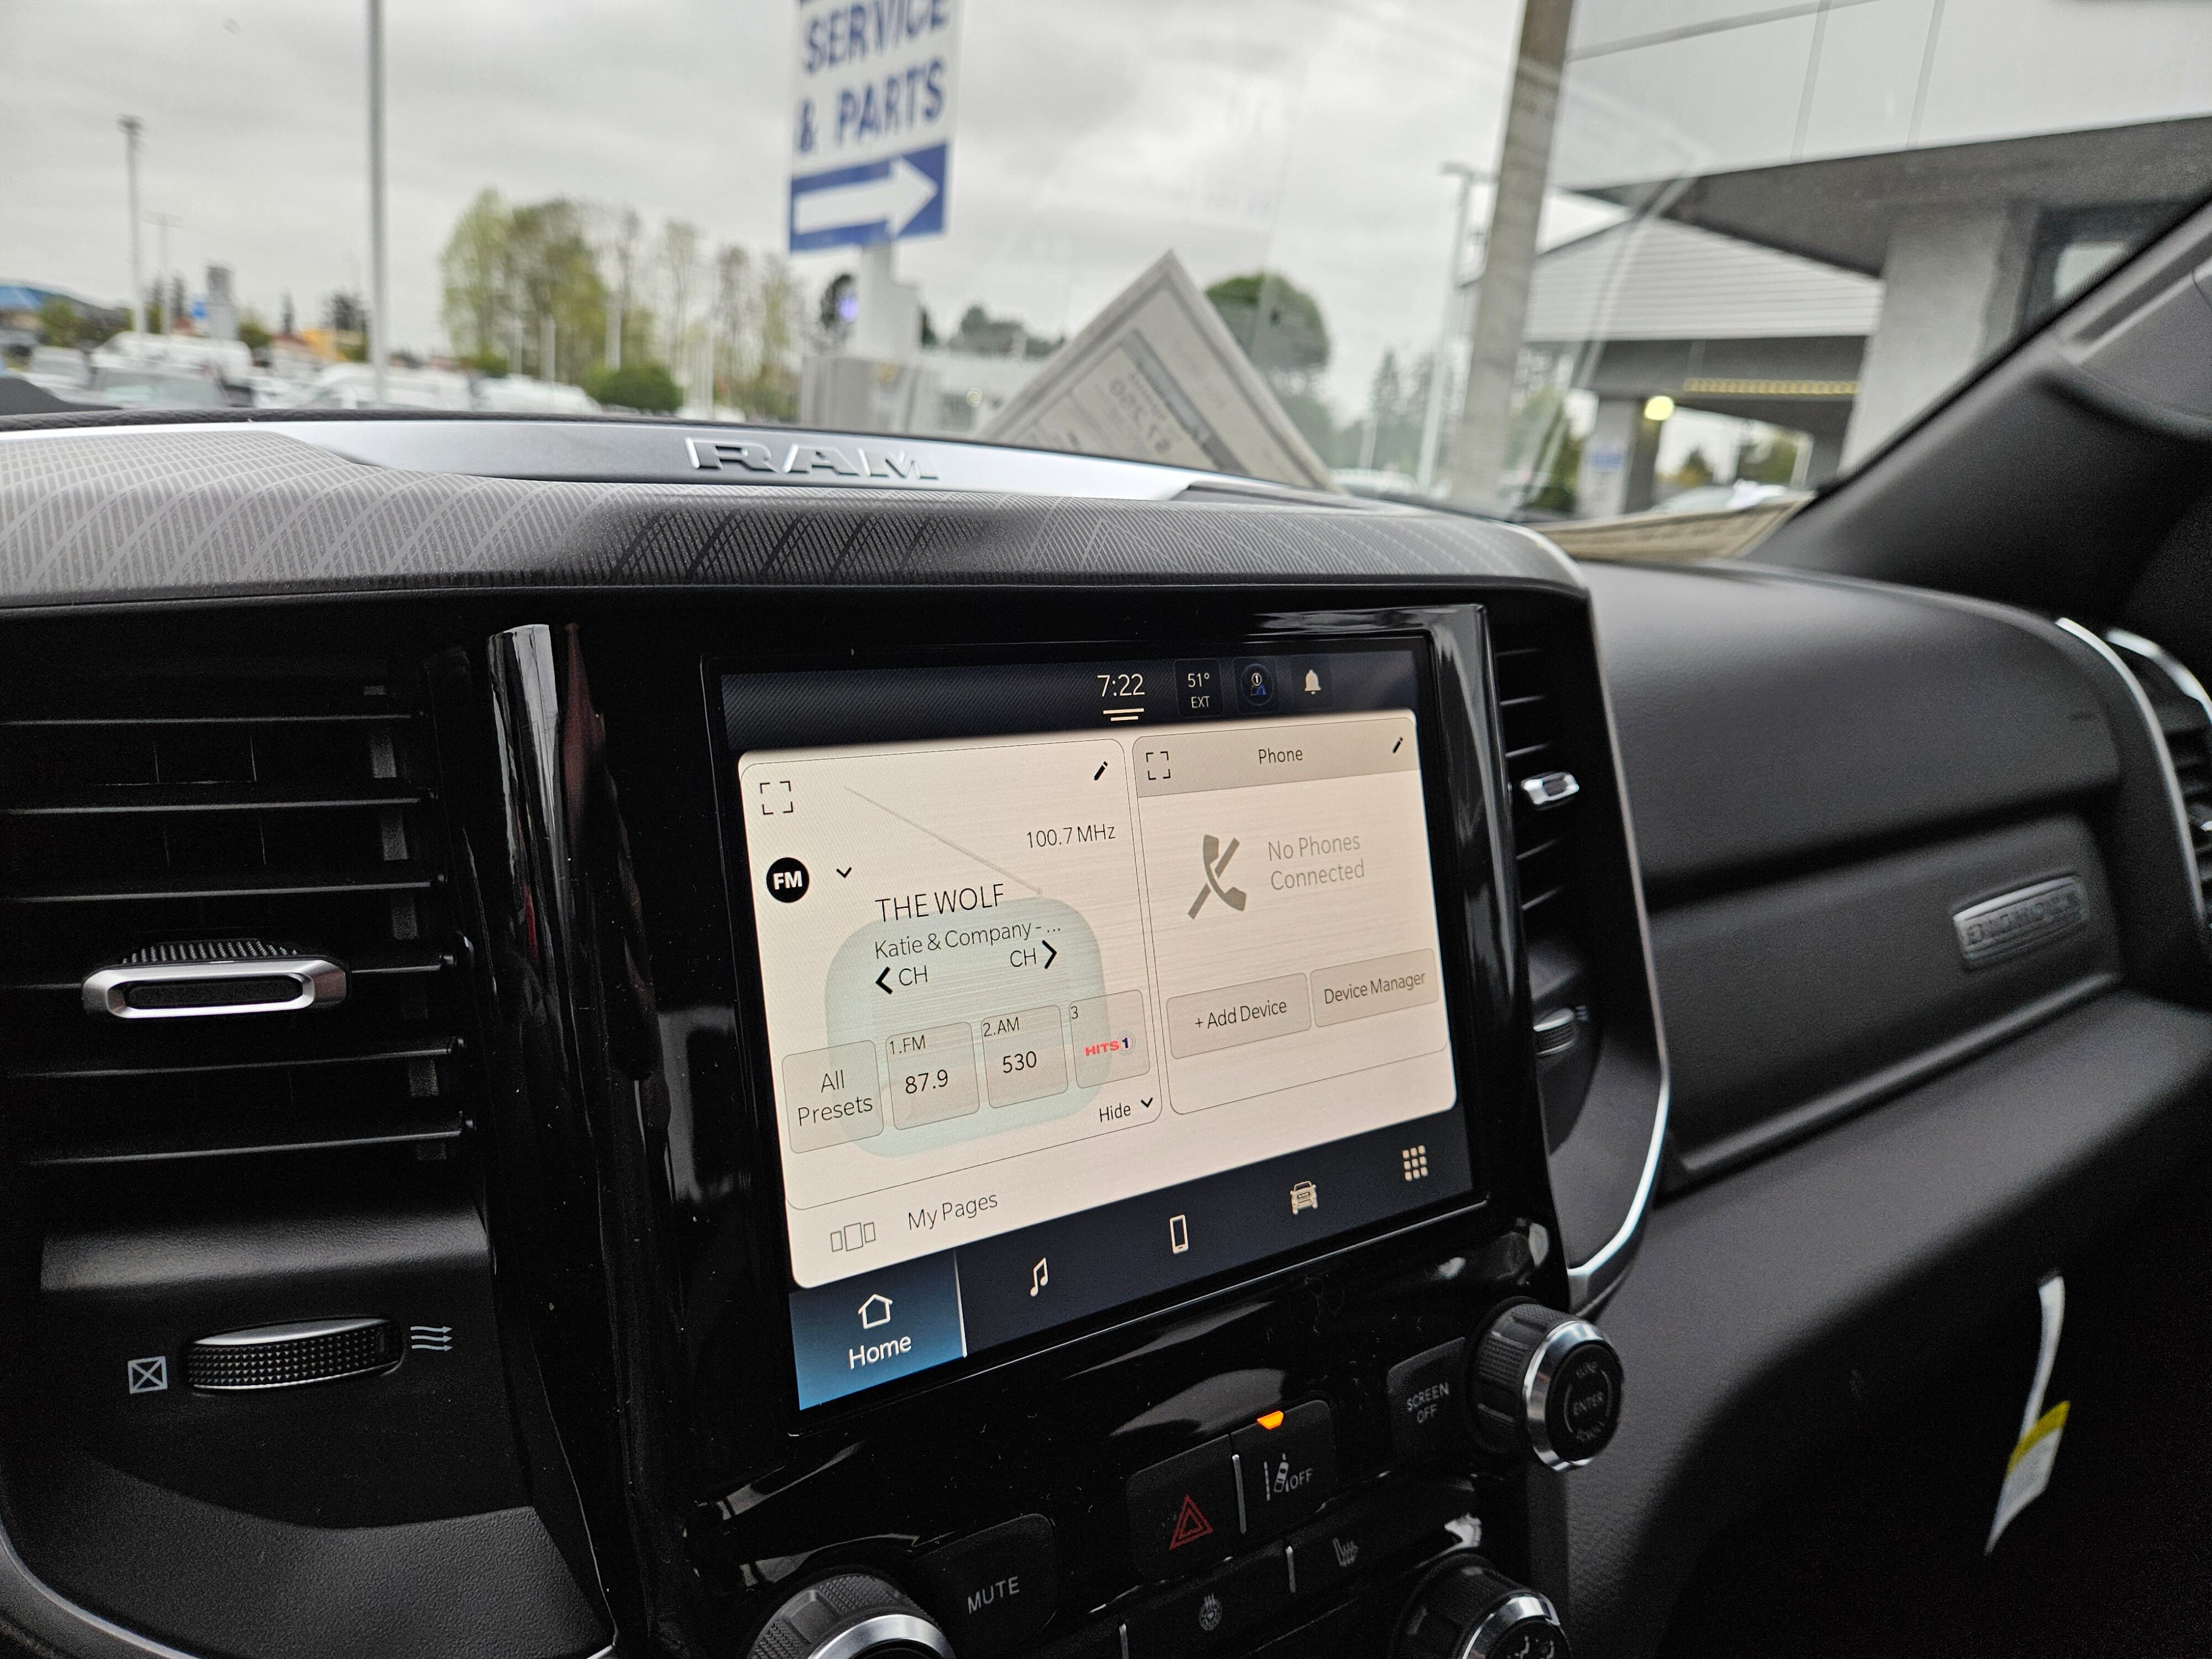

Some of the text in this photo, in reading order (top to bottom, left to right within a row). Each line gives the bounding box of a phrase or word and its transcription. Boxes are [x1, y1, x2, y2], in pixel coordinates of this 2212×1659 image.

[800, 59, 945, 155] & PARTS
[685, 437, 940, 480] RAM
[1097, 674, 1145, 697] 7:22
[1187, 672, 1210, 688] 51°
[1191, 695, 1210, 709] EXT
[1258, 747, 1303, 764] Phone
[1026, 823, 1116, 849] 100.7 MHz
[1267, 834, 1361, 861] No Phones
[773, 870, 803, 890] FM
[1271, 858, 1365, 890] Connected
[875, 883, 1004, 922] THE WOLF
[875, 936, 923, 959] Katie
[927, 932, 941, 952] &
[945, 922, 1032, 949] Company
[1009, 948, 1037, 968] CH
[898, 965, 928, 988] CH
[1324, 971, 1426, 1004] Device Manager
[1071, 1006, 1078, 1019] 3
[1207, 1006, 1237, 1029] Add
[1240, 999, 1287, 1022] Device
[982, 1017, 1020, 1037] 2.AM
[889, 1035, 926, 1055] 1.FM
[1002, 1050, 1037, 1073] 530
[820, 1070, 846, 1093] All
[905, 1069, 949, 1094] 87.9
[797, 1095, 873, 1126] Presets
[1099, 1102, 1131, 1123] Hide
[907, 1193, 998, 1230] My Pages
[848, 1335, 911, 1370] Home
[1406, 1382, 1449, 1411] SCREEN
[1417, 1404, 1437, 1423] OFF
[1289, 1468, 1313, 1490] OFF
[967, 1575, 1020, 1614] MUTE
